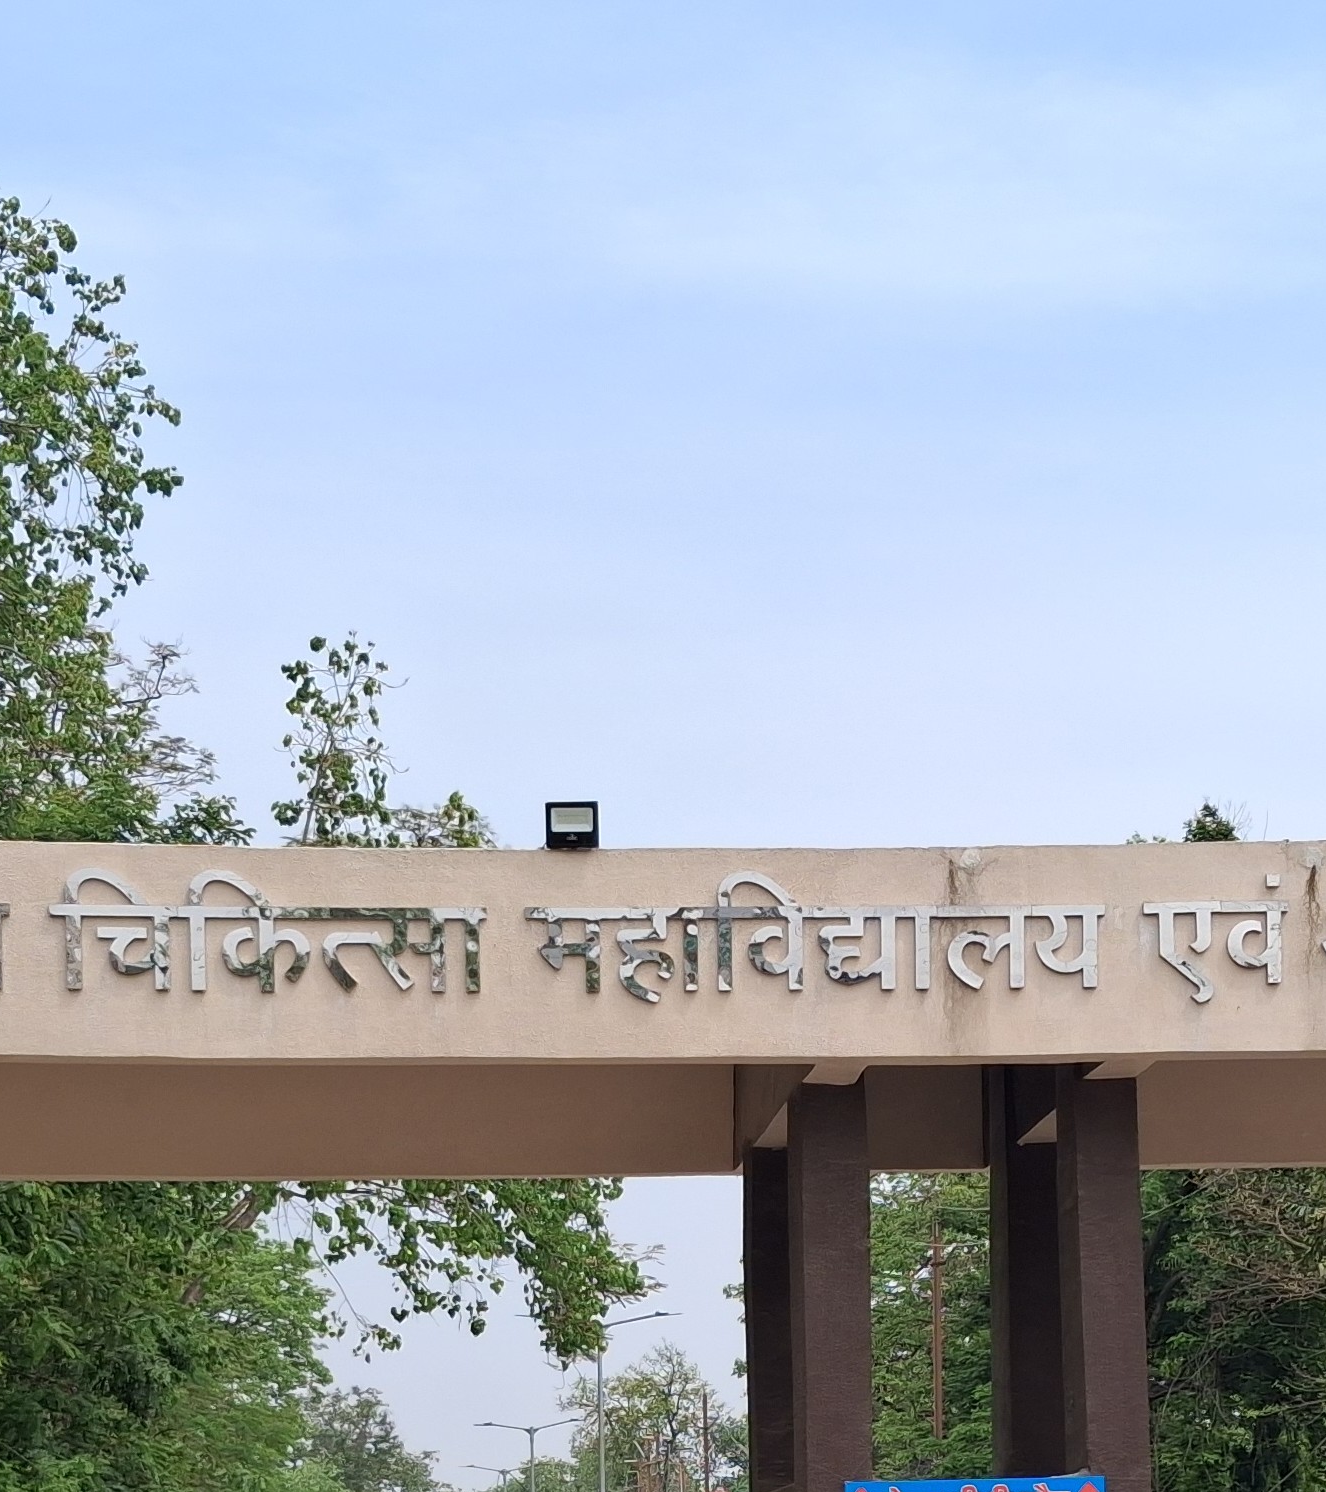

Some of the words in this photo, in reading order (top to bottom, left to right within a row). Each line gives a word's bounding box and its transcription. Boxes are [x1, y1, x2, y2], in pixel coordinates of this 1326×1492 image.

[49, 867, 487, 993] चिकित्सा
[525, 870, 1105, 1004] महाविद्यालय
[1143, 873, 1289, 1004] एवं
